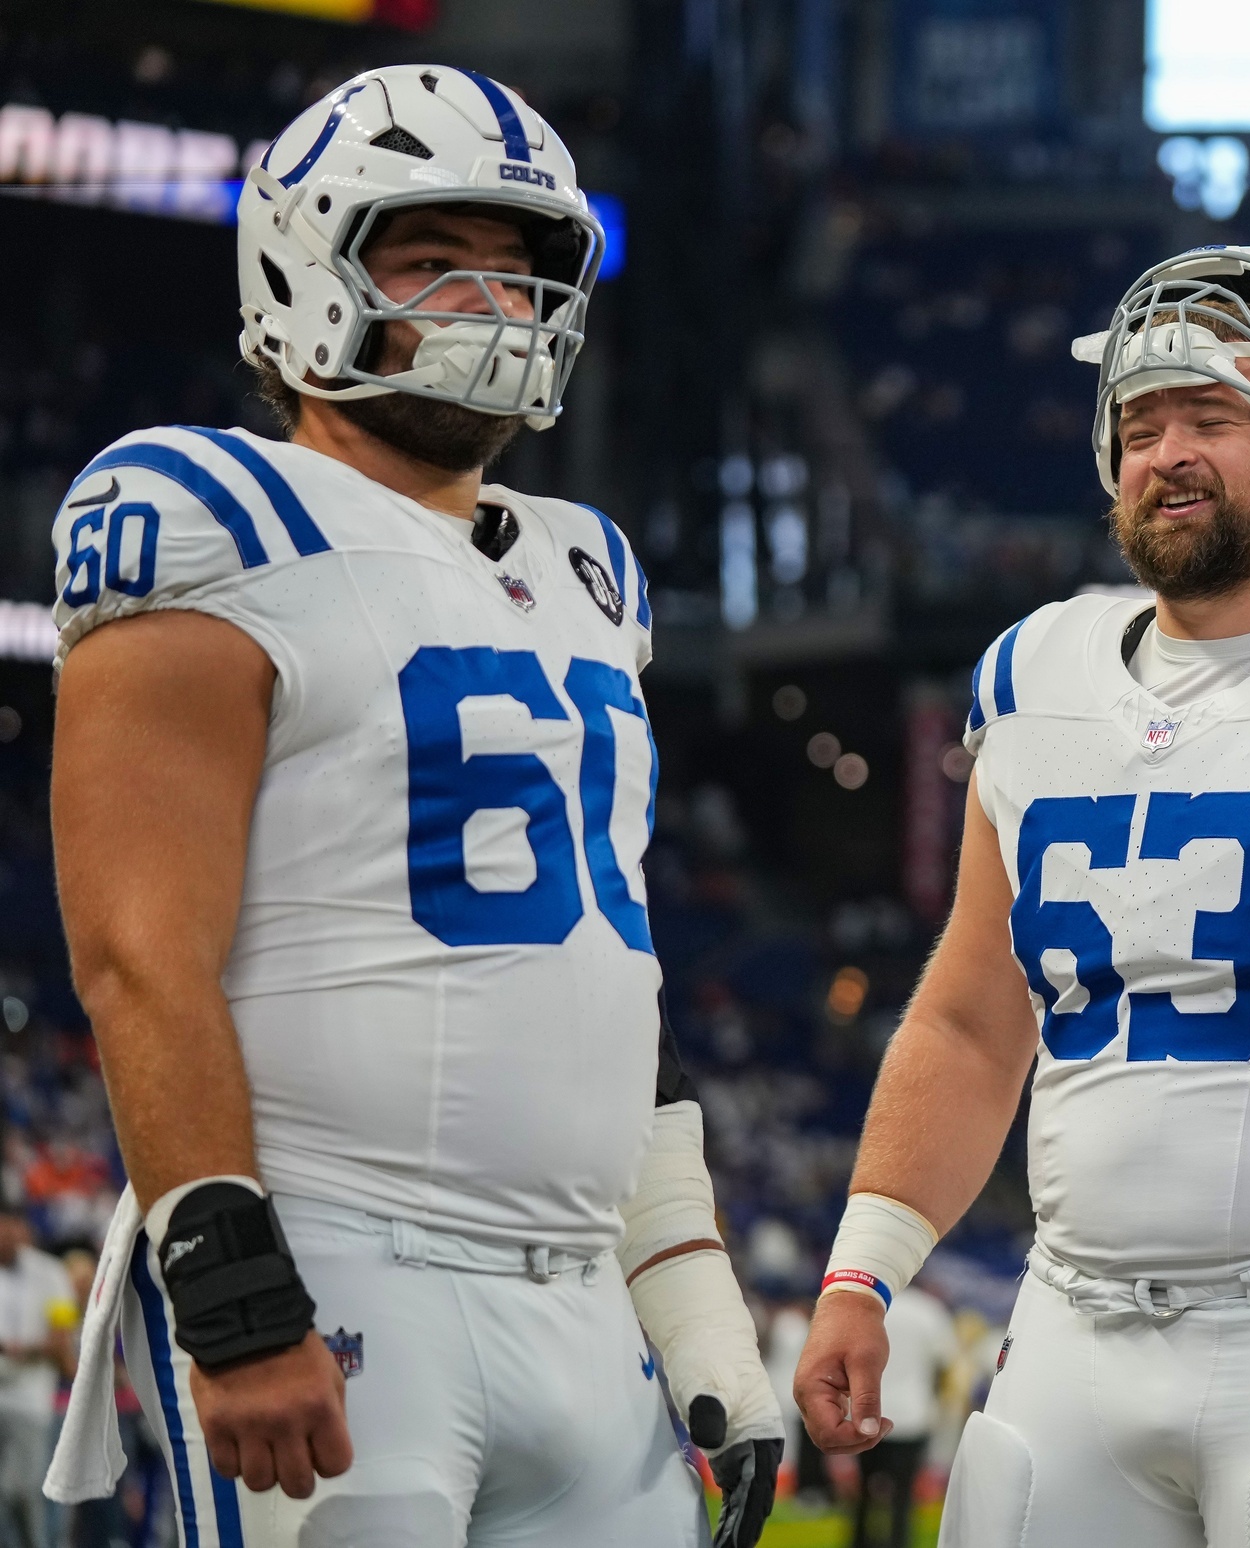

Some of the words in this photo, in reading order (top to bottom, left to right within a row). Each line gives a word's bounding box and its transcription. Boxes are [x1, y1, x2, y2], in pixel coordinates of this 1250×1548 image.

[499, 163, 556, 190] COLTS
[63, 501, 161, 609] 60
[1146, 730, 1168, 744] NFL
[398, 645, 659, 956] 60
[858, 1273, 875, 1285] Trey
